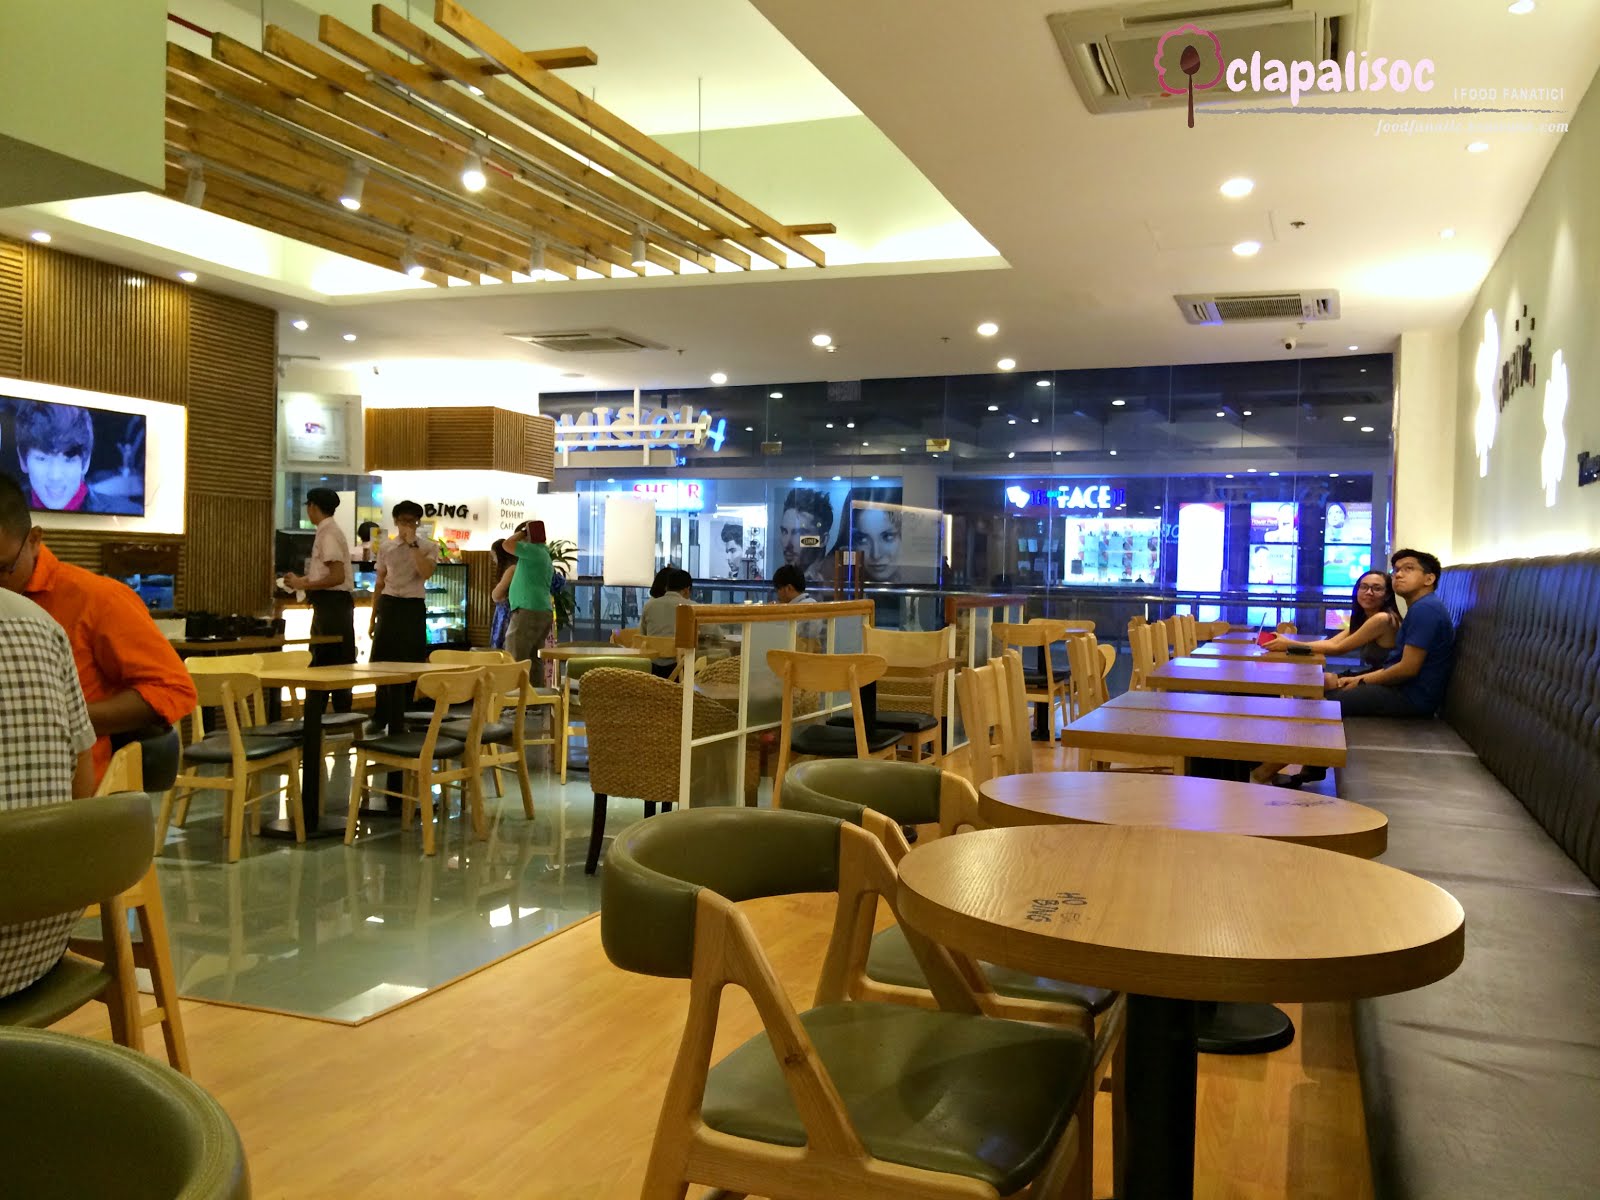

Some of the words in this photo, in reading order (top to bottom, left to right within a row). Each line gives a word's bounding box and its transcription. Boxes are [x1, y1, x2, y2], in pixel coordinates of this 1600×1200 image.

[500, 496, 525, 508] KOREAN
[1056, 485, 1111, 509] FACE
[423, 502, 469, 519] BING
[500, 508, 524, 519] DESSERT
